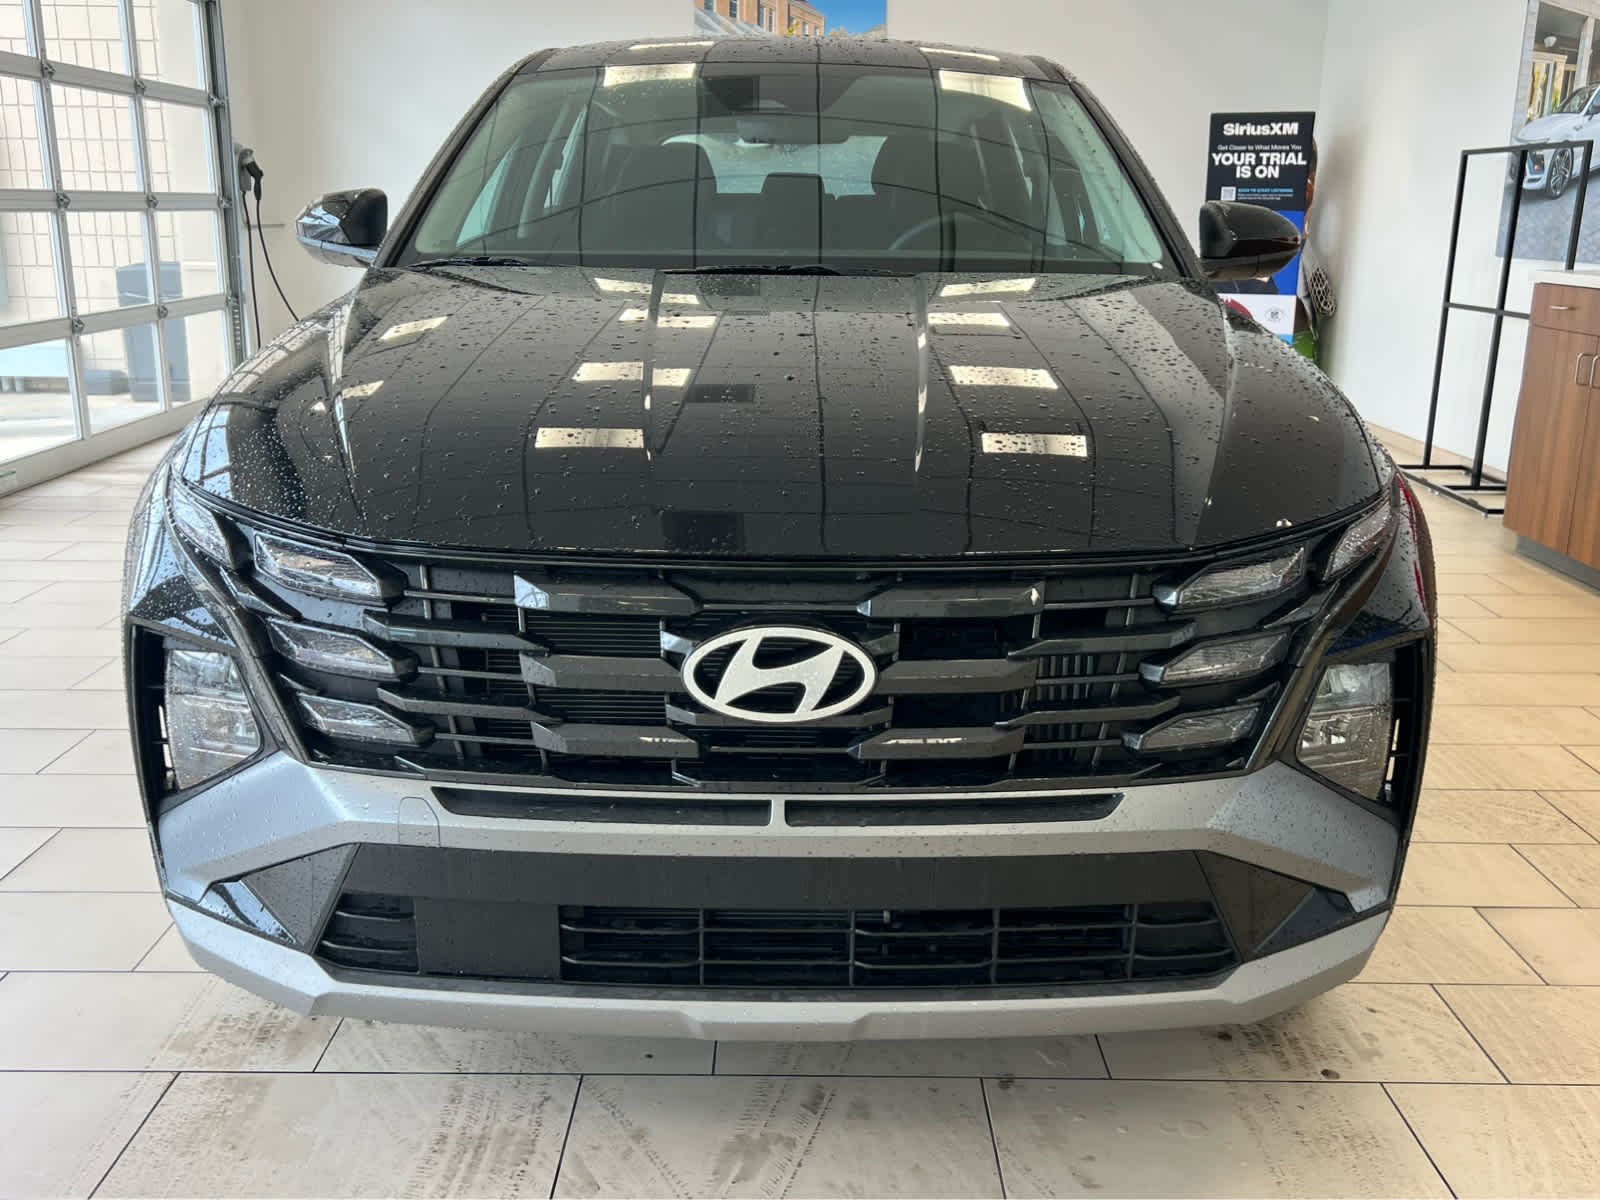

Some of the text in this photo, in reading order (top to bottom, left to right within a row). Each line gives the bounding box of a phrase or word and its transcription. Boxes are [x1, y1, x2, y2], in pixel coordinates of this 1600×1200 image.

[1223, 122, 1299, 136] SiriusXM
[1212, 152, 1307, 166] YOUR TRIAL
[1236, 165, 1280, 178] IS ON
